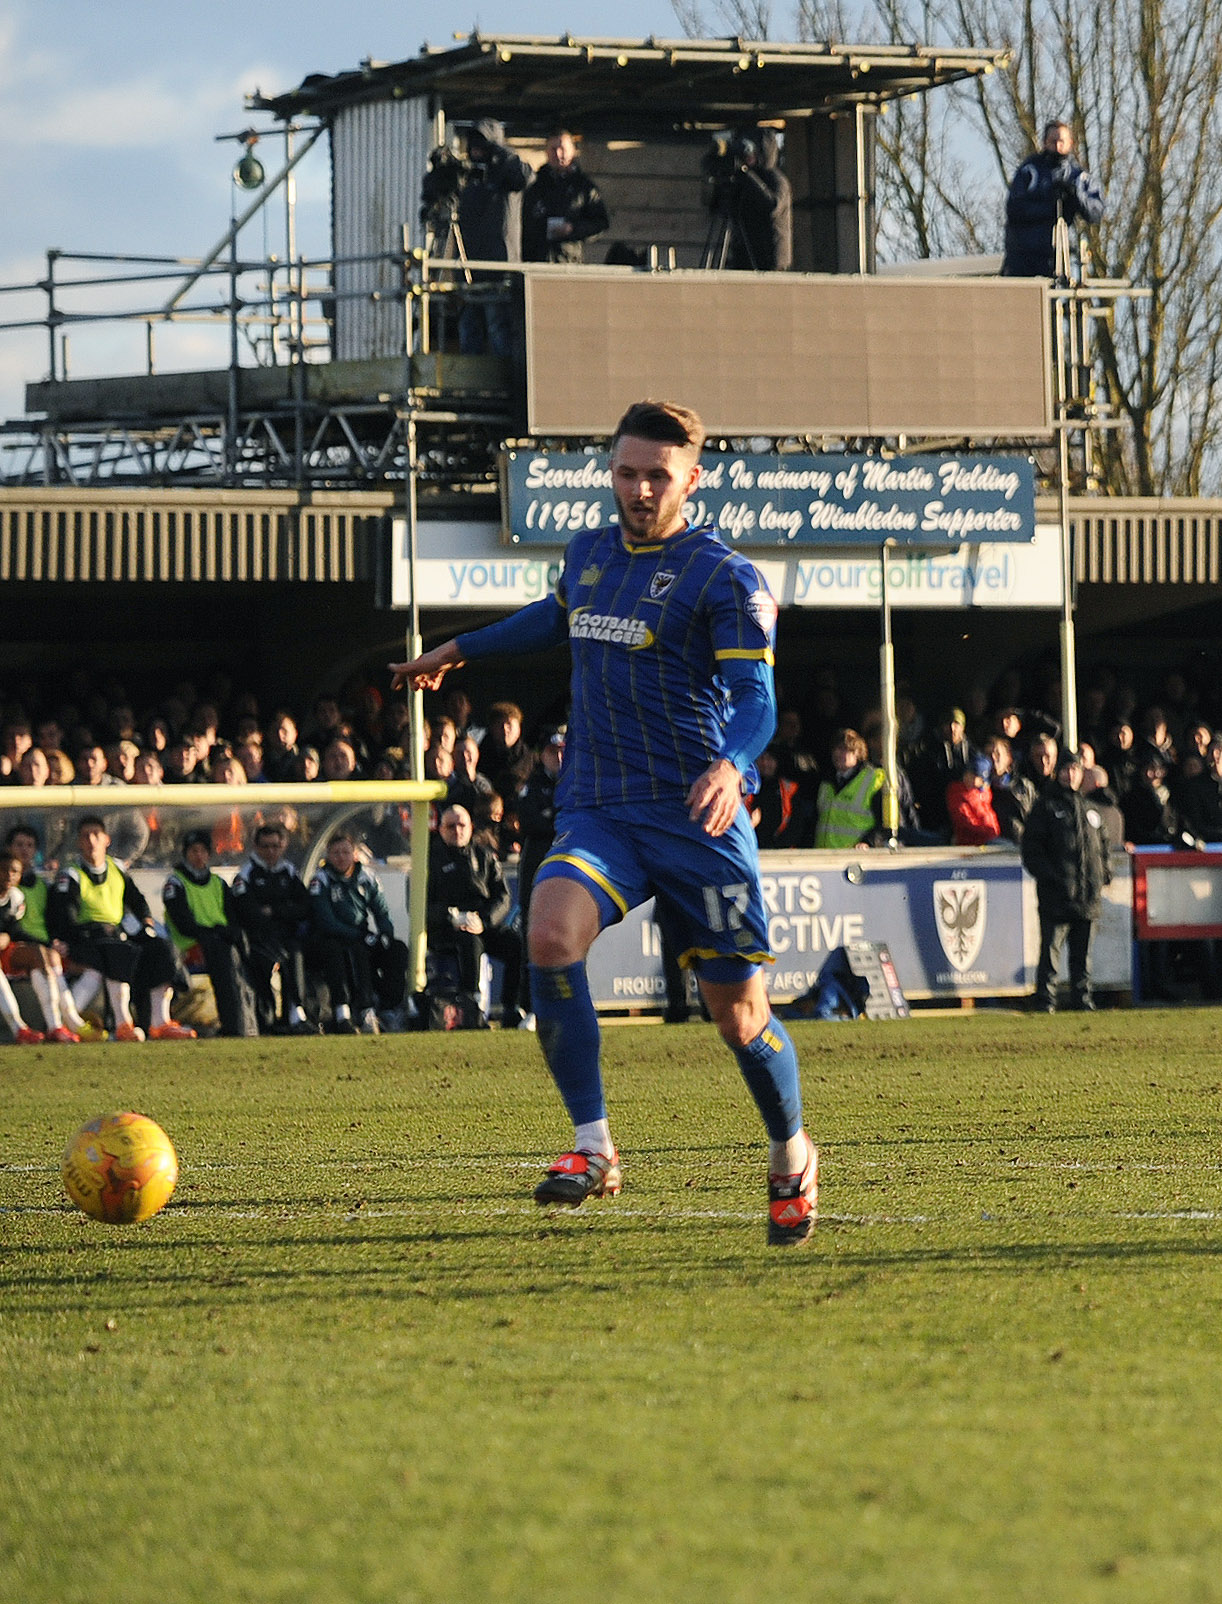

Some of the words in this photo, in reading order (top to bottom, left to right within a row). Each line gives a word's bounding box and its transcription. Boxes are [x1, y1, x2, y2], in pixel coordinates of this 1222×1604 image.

[526, 457, 614, 490] Scoreboa
[728, 459, 755, 490] In
[757, 470, 832, 498] memory
[835, 462, 859, 500] of
[862, 460, 935, 492] Martin
[938, 460, 1021, 500] Fielding
[525, 500, 602, 531] (1956
[718, 501, 757, 539] life
[758, 501, 803, 539] long
[808, 500, 918, 530] Wimbledon
[921, 500, 1022, 538] Supporter
[449, 562, 560, 598] yourgo
[569, 625, 646, 645] MANAGER
[572, 612, 647, 633] FOOTBALL
[762, 875, 823, 914] RTS
[767, 913, 865, 953] CTIVE
[613, 976, 666, 996] PROUD
